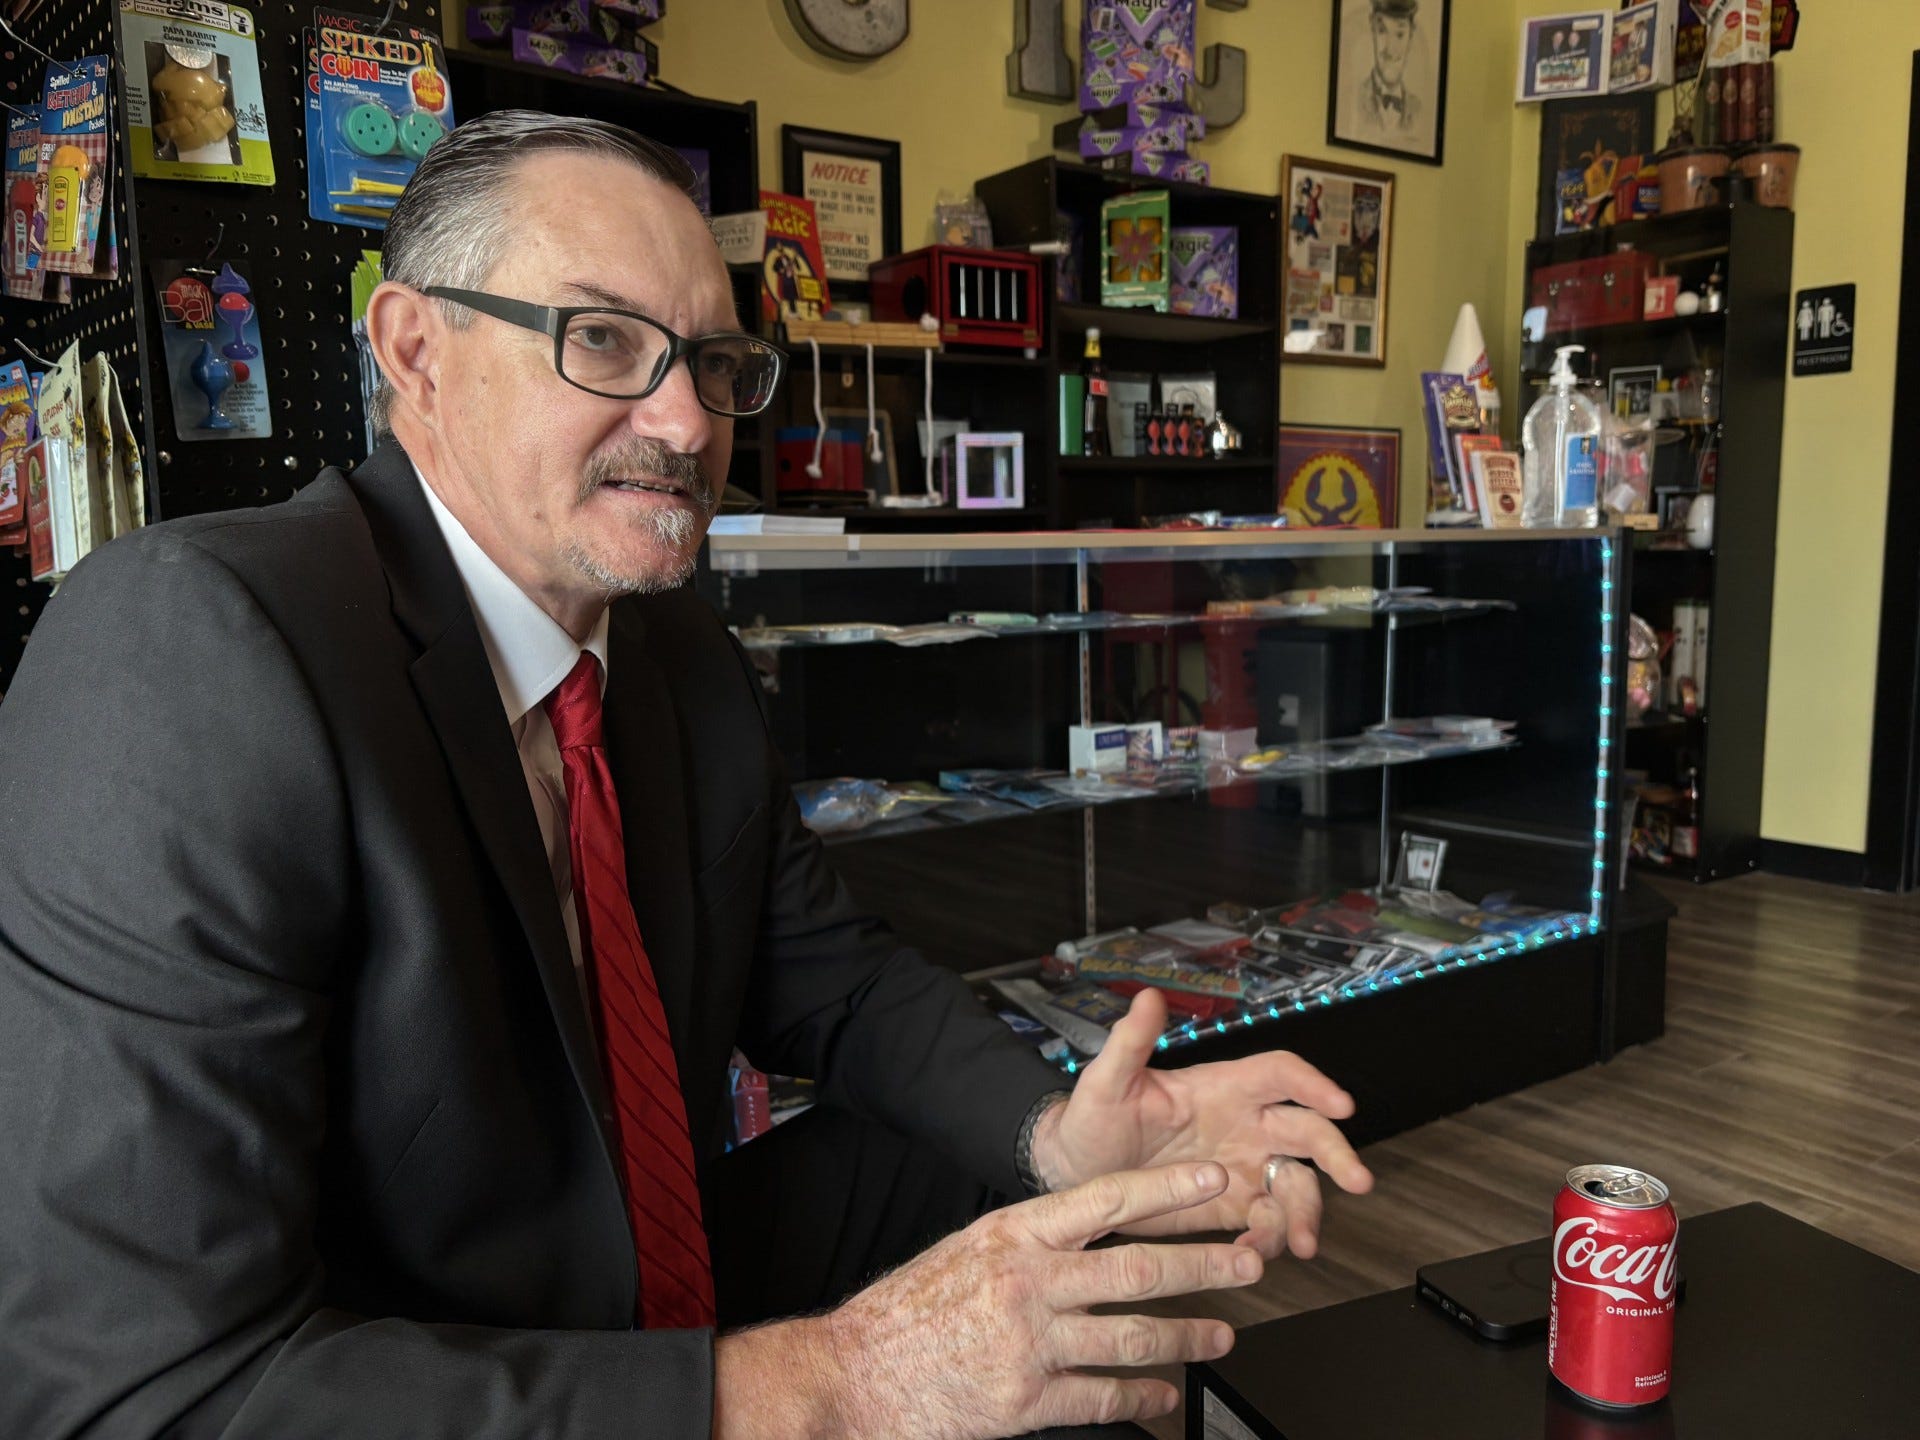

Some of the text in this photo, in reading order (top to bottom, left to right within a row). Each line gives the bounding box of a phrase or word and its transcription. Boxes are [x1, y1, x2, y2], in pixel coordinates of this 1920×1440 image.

[136, 4, 165, 14] PRANKS
[204, 18, 229, 29] MAGIC
[319, 14, 361, 32] MAGIC
[163, 26, 217, 42] PAPA RABBIT
[164, 33, 217, 49] Goes to Town
[321, 27, 422, 65] SPIKED
[321, 53, 380, 82] COIN
[50, 74, 70, 90] Spilled
[47, 81, 98, 111] KETCHUP &
[62, 93, 104, 129] MUSTARD
[42, 143, 56, 152] GREAT
[810, 162, 871, 185] NOTICE
[855, 235, 869, 246] NO
[1172, 236, 1212, 253] agic
[159, 290, 214, 323] Ball
[1553, 1216, 1678, 1304] Coca-C
[1606, 1305, 1664, 1317] ORIGINAL
[1635, 1373, 1663, 1382] Delicious
[1635, 1376, 1667, 1388] Refreshing
